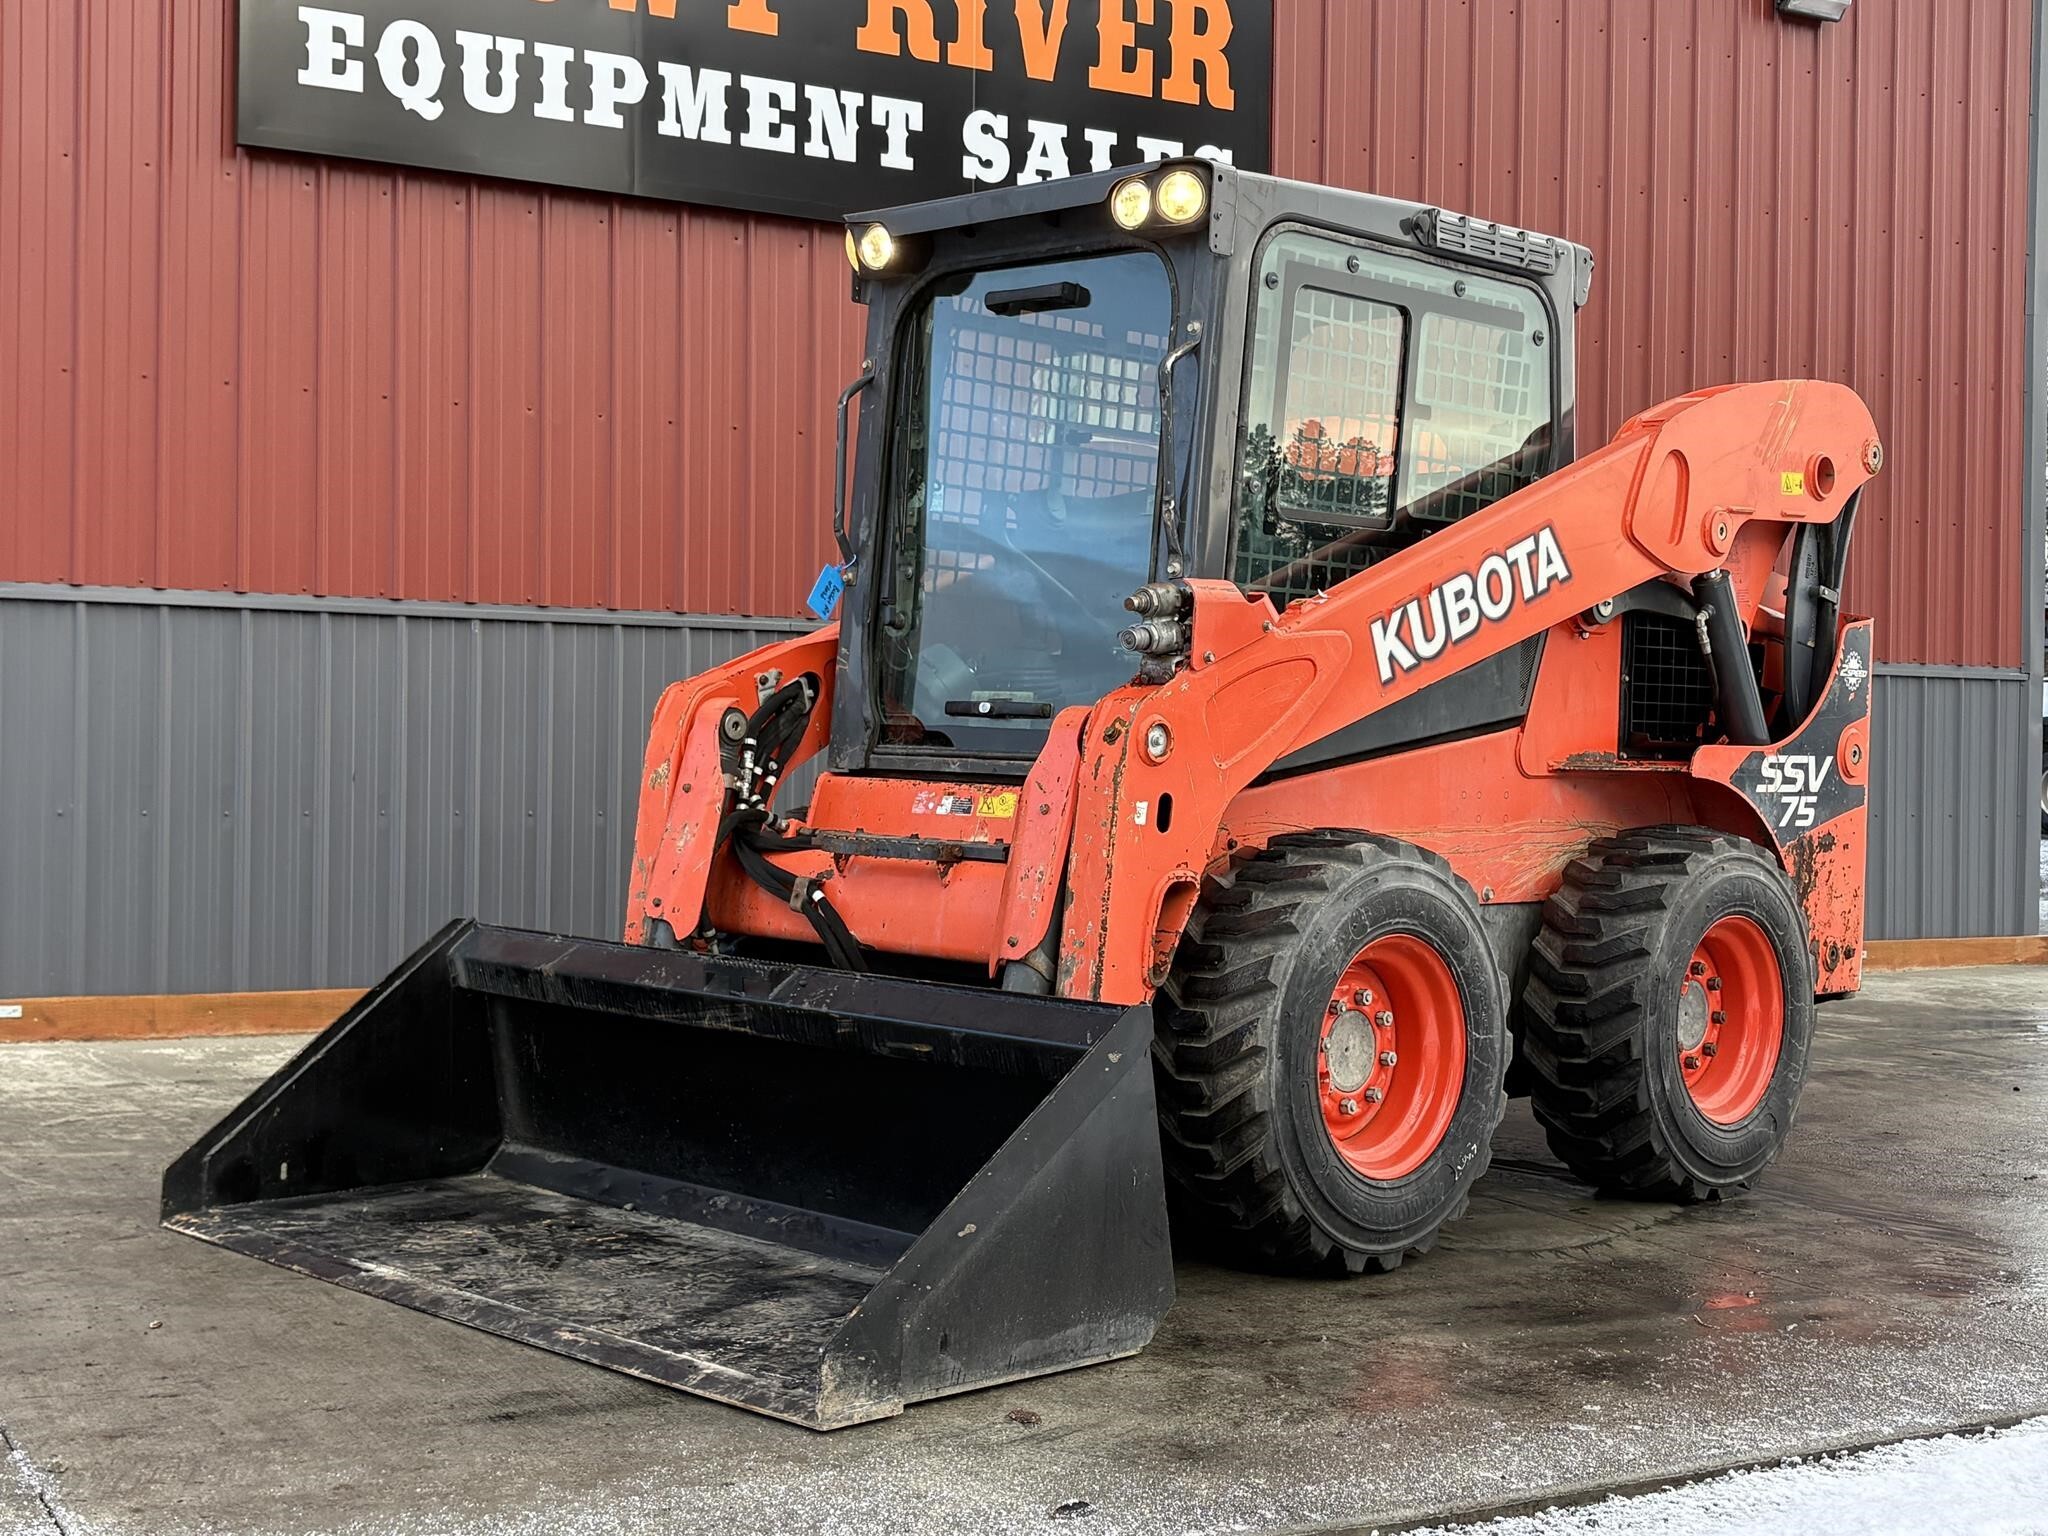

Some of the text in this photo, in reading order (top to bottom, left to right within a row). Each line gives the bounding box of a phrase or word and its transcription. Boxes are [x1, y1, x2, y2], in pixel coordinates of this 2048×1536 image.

[298, 6, 1232, 185] EQUIPMENT SAL
[857, 0, 1234, 111] RIVER
[1370, 526, 1572, 685] KUBOTA
[1756, 755, 1833, 793] SSV
[1779, 796, 1817, 827] 75
